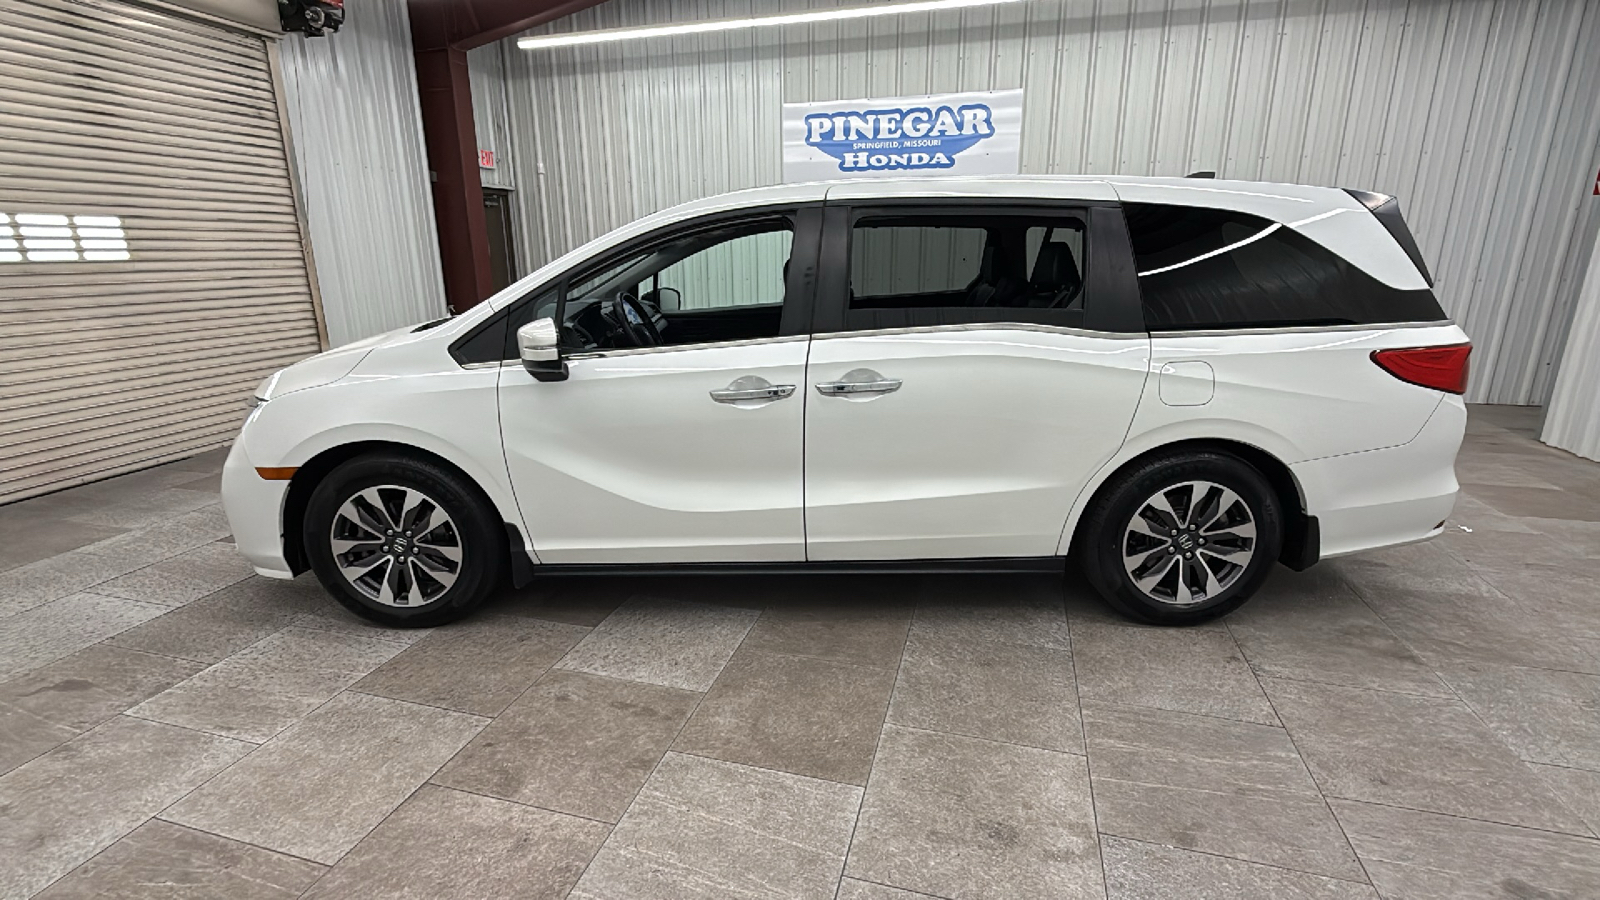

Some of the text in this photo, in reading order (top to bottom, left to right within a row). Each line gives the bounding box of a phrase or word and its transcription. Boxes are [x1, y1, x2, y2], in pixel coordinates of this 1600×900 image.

[808, 107, 991, 142] PINEGAR
[852, 139, 942, 150] SPRINGFIELD, MISSOURI
[480, 149, 494, 167] EXIT
[841, 151, 952, 168] HONDA
